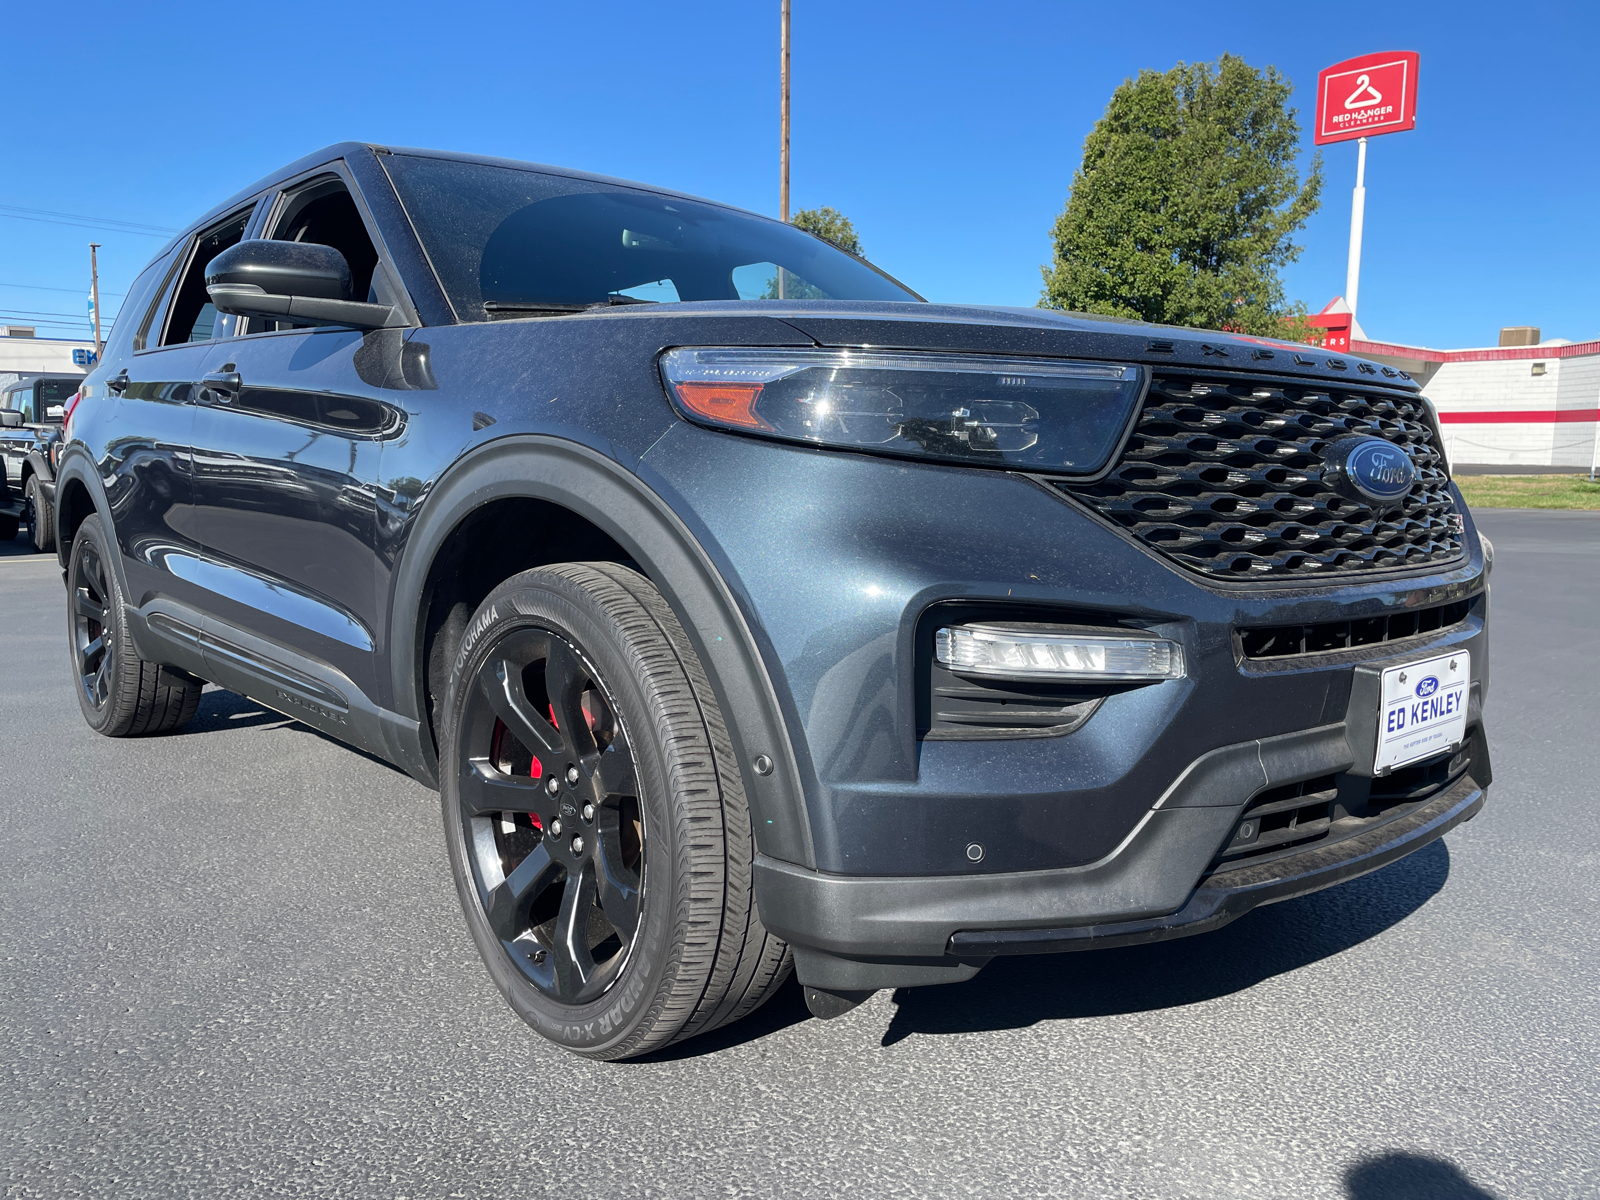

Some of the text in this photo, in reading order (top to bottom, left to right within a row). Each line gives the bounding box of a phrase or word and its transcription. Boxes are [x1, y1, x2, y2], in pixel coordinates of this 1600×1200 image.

[1333, 113, 1350, 123] RED
[1340, 115, 1384, 128] CLEANERS
[1370, 452, 1406, 484] Ford
[453, 604, 499, 677] YOKOHAMA
[1420, 679, 1436, 696] Ford
[1387, 690, 1462, 733] ED KENLEY
